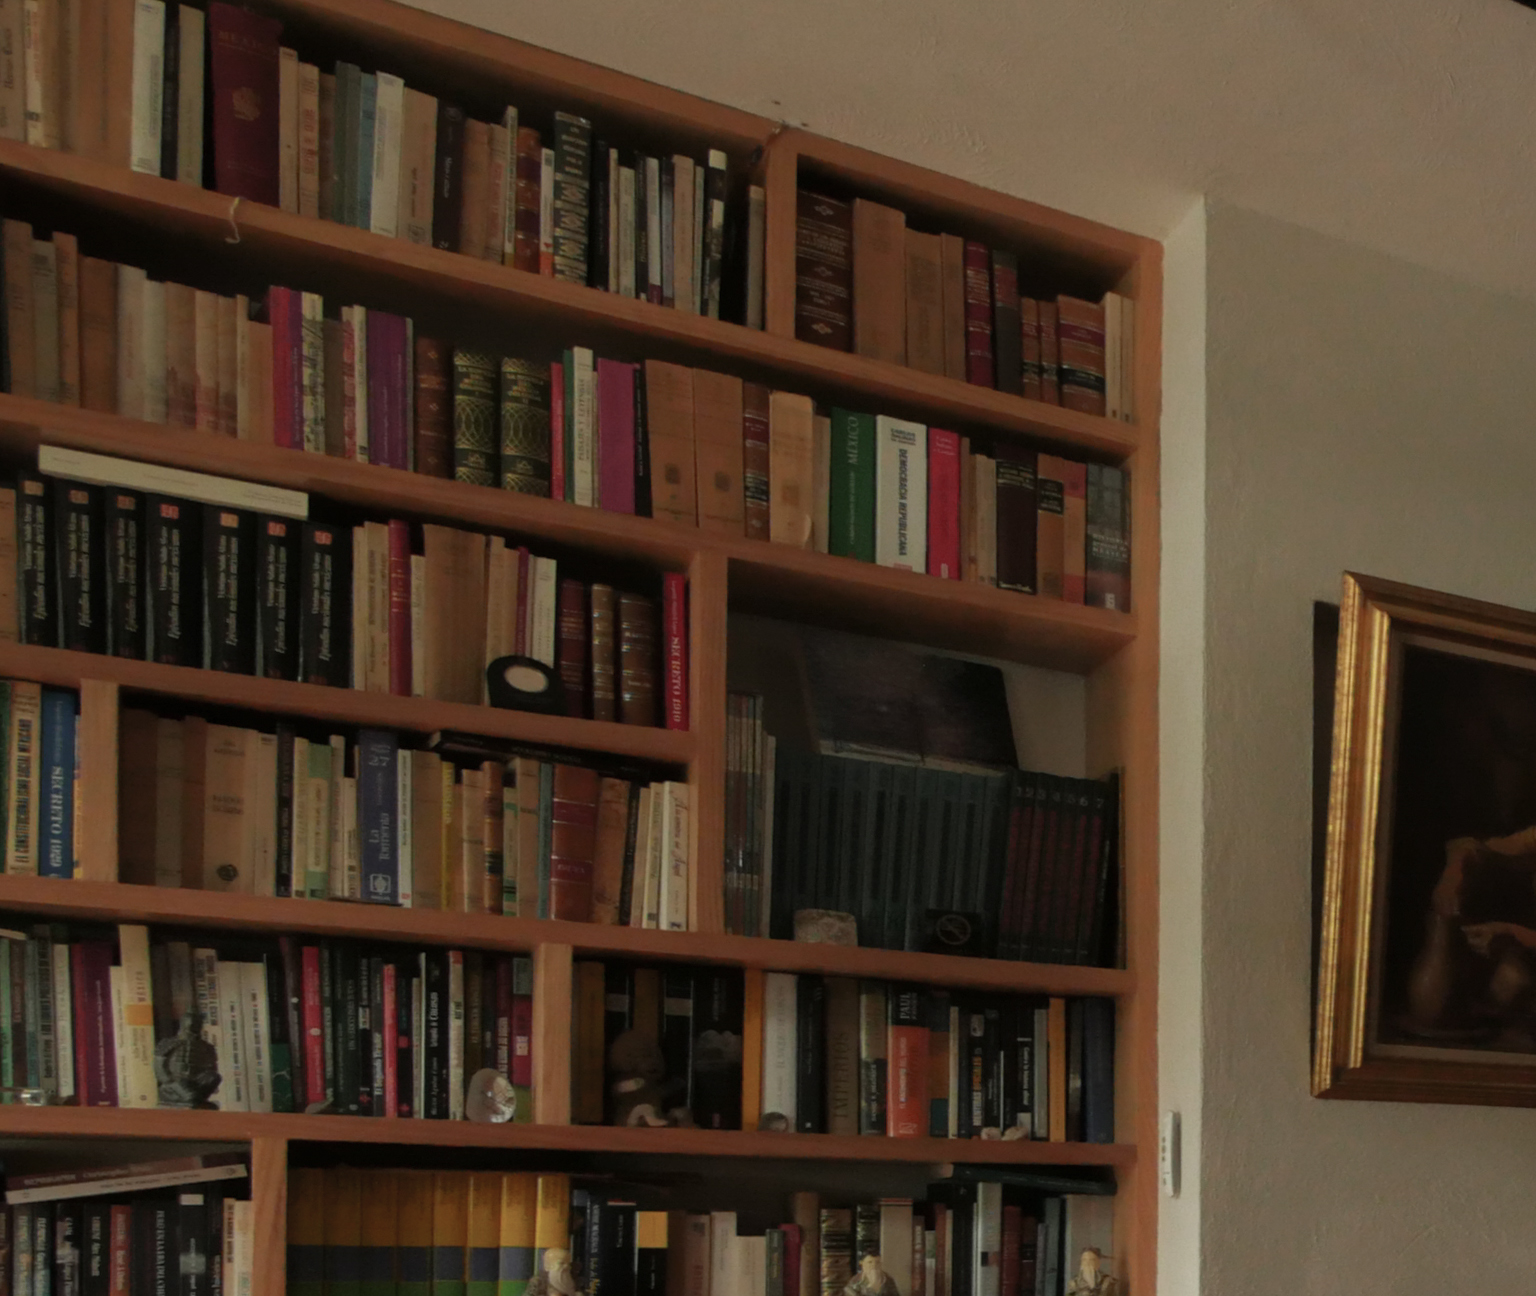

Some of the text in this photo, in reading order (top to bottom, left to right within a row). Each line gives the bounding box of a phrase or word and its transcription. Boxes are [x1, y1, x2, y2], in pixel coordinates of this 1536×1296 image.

[899, 449, 908, 556] DEMOCRACIA REPUBLICANA
[670, 636, 682, 722] SECRETO 1910
[369, 830, 380, 843] La
[899, 992, 910, 1019] PAUL
[832, 1032, 849, 1119] IMPERIOS
